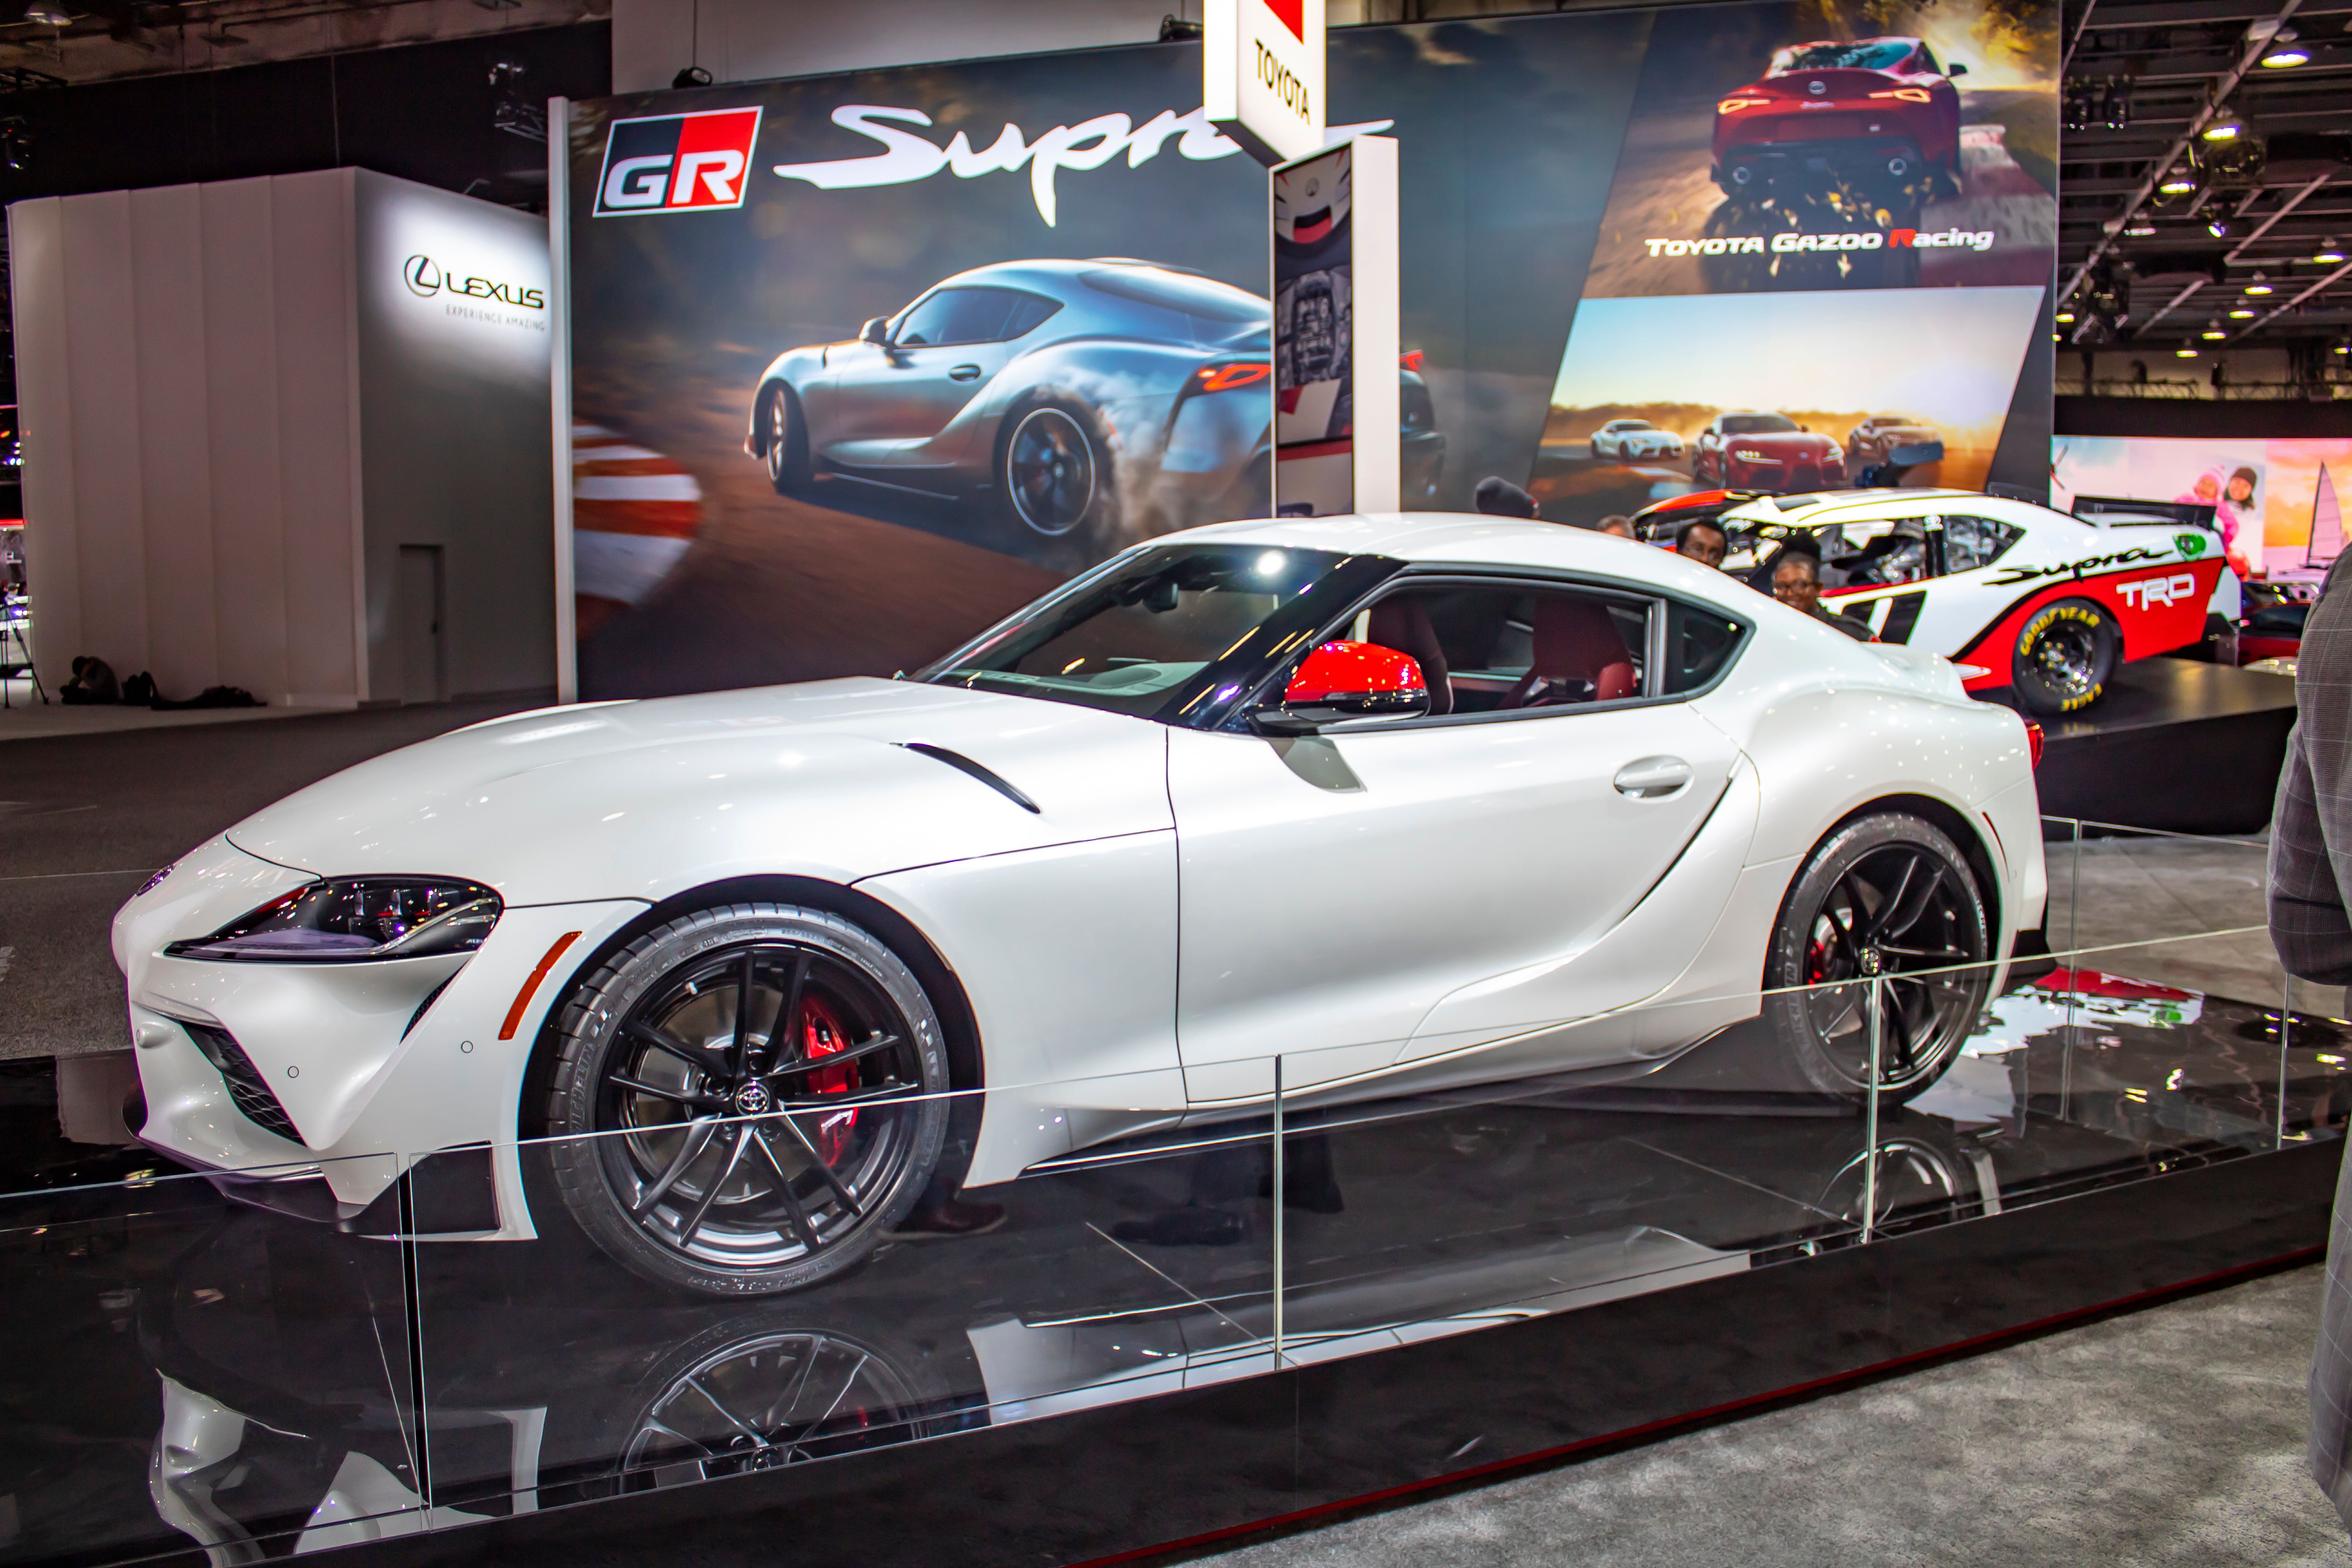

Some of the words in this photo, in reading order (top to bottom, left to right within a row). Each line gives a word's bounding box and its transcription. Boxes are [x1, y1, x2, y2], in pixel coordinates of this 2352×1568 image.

[1255, 38, 1310, 126] TOYOTA
[604, 149, 745, 208] GR
[1644, 236, 1765, 257] TOYOTA
[1770, 232, 1883, 253] GAZOO
[1889, 227, 1995, 252] Racing
[446, 271, 544, 309] LEXUS
[446, 304, 502, 325] EXPERIENCE
[505, 316, 545, 333] AMAZING
[1981, 547, 2174, 584] Supra
[2116, 573, 2195, 612] TRD
[2020, 607, 2101, 656] GOODYEAR
